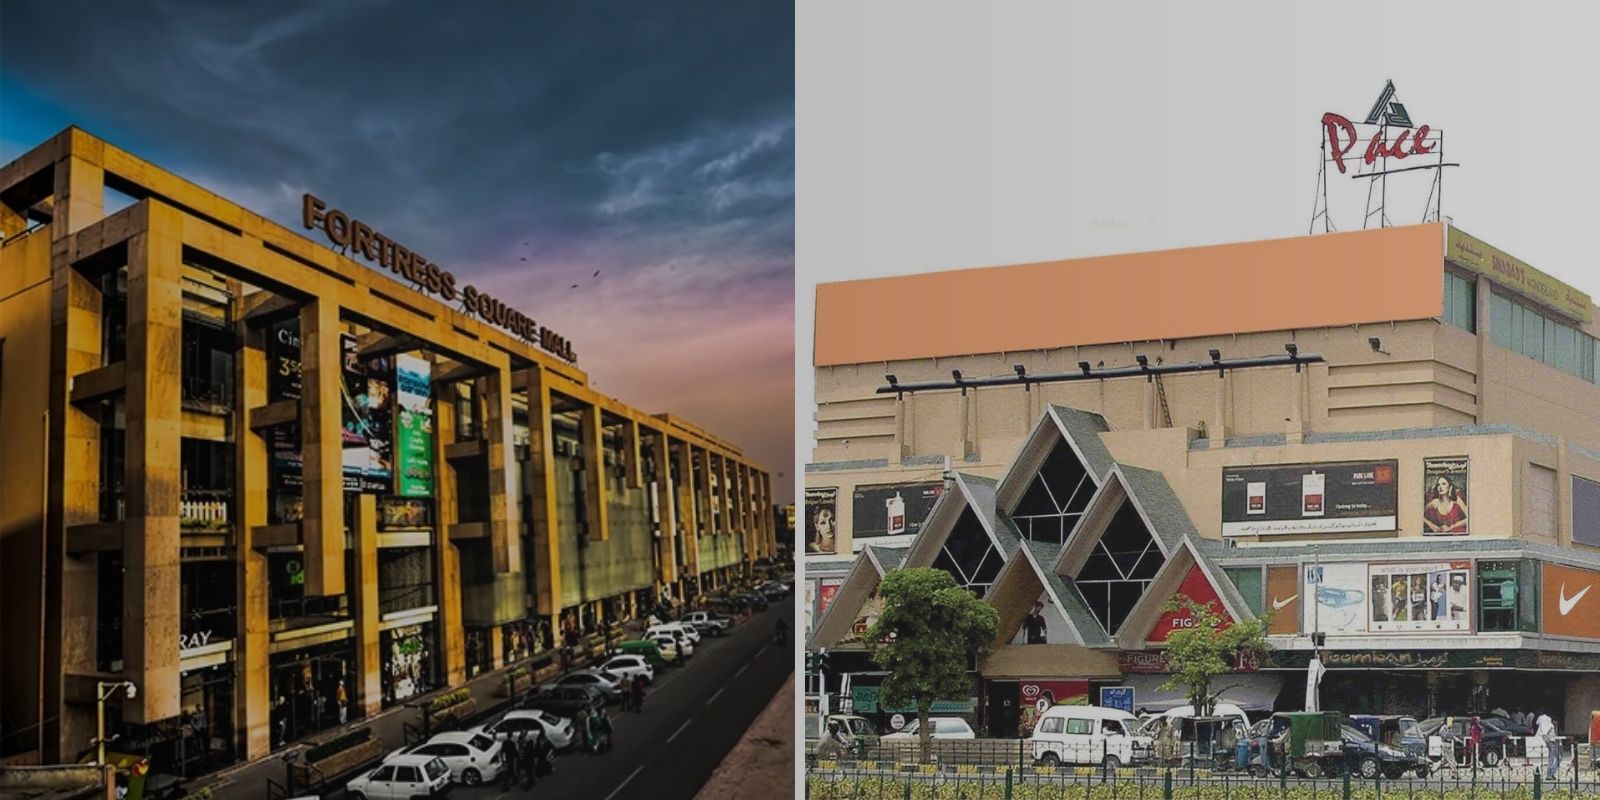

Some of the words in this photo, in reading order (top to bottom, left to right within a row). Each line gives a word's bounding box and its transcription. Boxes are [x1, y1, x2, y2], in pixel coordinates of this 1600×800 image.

[1321, 112, 1436, 174] Pace
[302, 193, 457, 301] FORTRESS
[462, 285, 539, 343] SQUARE
[540, 326, 577, 362] MALL
